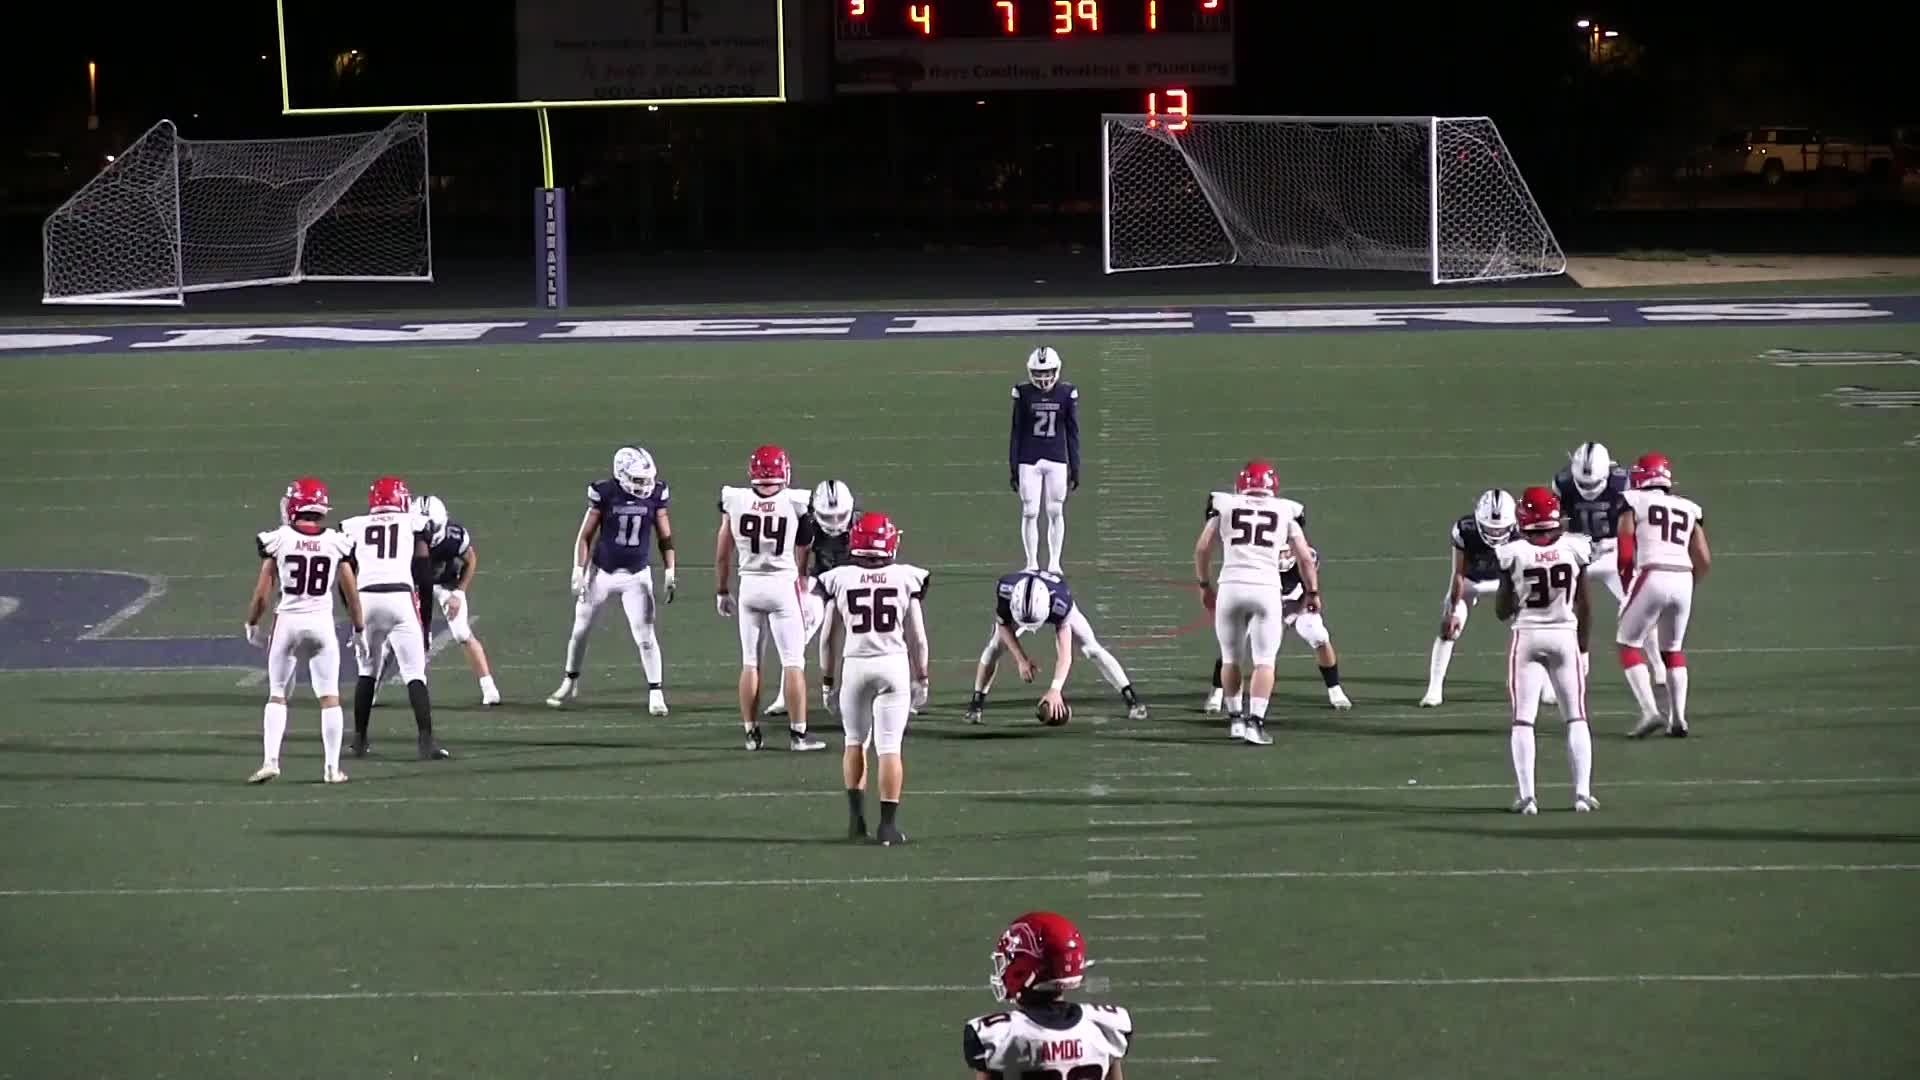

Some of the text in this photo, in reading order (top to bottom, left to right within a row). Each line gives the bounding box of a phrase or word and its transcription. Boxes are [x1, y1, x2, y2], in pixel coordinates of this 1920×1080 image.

[910, 4, 931, 35] 4
[995, 0, 1014, 33] 7
[1055, 0, 1098, 34] 39
[1149, 0, 1157, 30] 1
[1148, 88, 1188, 130] 13
[1033, 411, 1056, 437] 21
[364, 523, 400, 559] 91
[614, 514, 642, 547] 11
[739, 513, 787, 557] 94
[1231, 508, 1278, 547] 52
[1648, 505, 1689, 545] 92
[283, 554, 332, 596] 38
[1523, 563, 1573, 609] 39
[846, 588, 898, 634] 56
